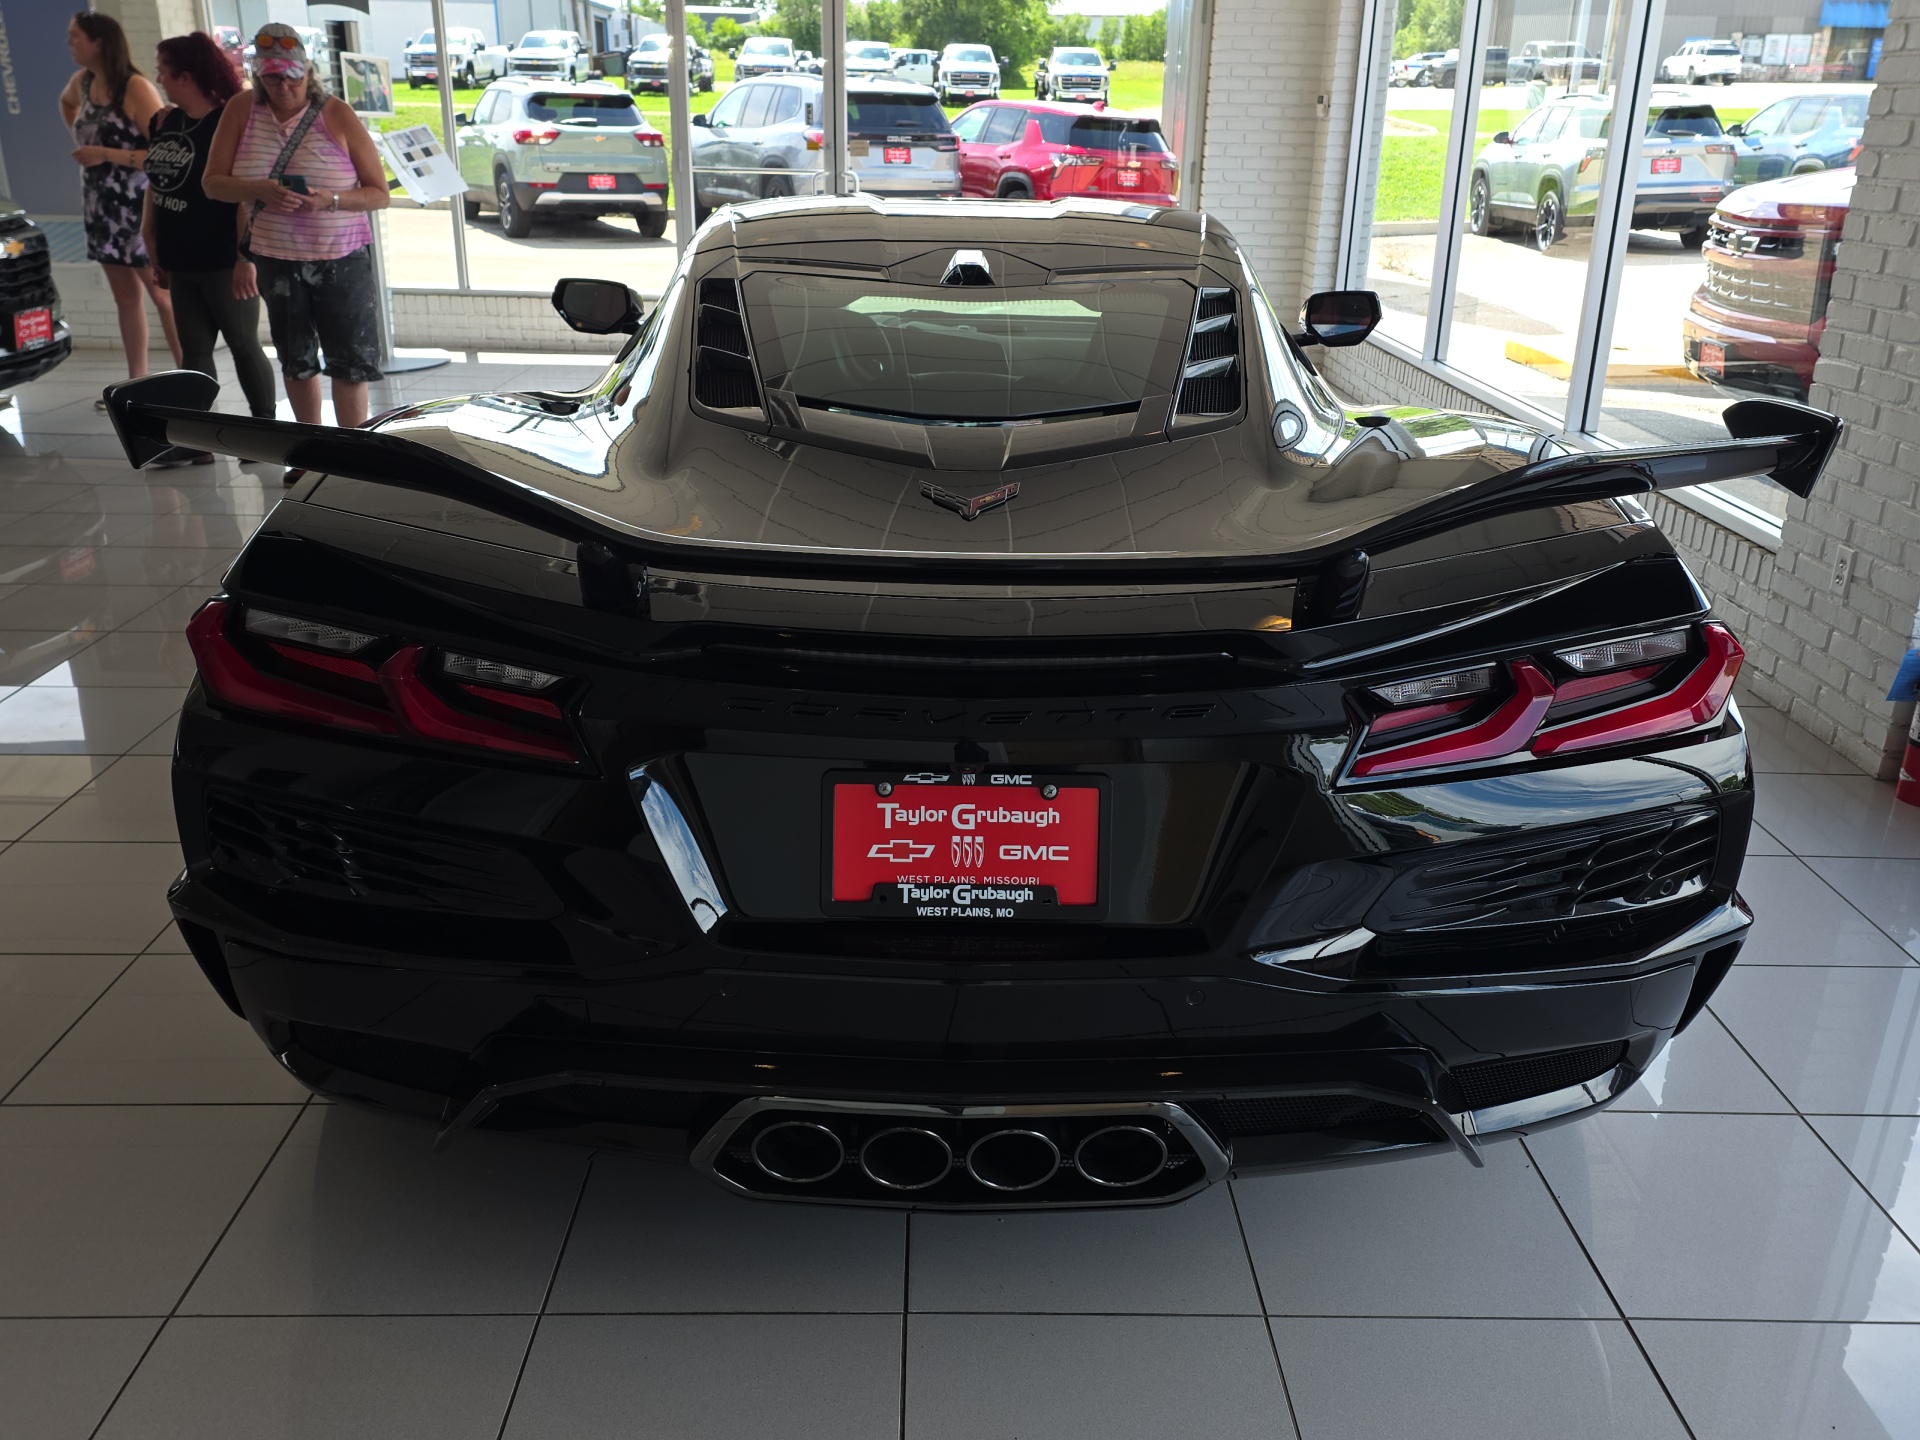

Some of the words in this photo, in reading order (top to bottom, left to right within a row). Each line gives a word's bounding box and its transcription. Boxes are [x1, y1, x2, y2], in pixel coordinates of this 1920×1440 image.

[164, 196, 188, 212] HOP
[721, 696, 1217, 726] CORVETTE
[990, 774, 1032, 785] GMC
[877, 803, 947, 829] Taylor
[951, 803, 1060, 830] Grubaugh
[999, 845, 1070, 861] GMC
[897, 875, 930, 884] WEST
[983, 876, 1040, 886] MISSOURI
[897, 884, 950, 904] Taylor
[952, 884, 1034, 905] Grubaugh
[916, 906, 949, 917] WEST
[950, 907, 994, 919] PLAINS,
[996, 908, 1014, 918] MO
